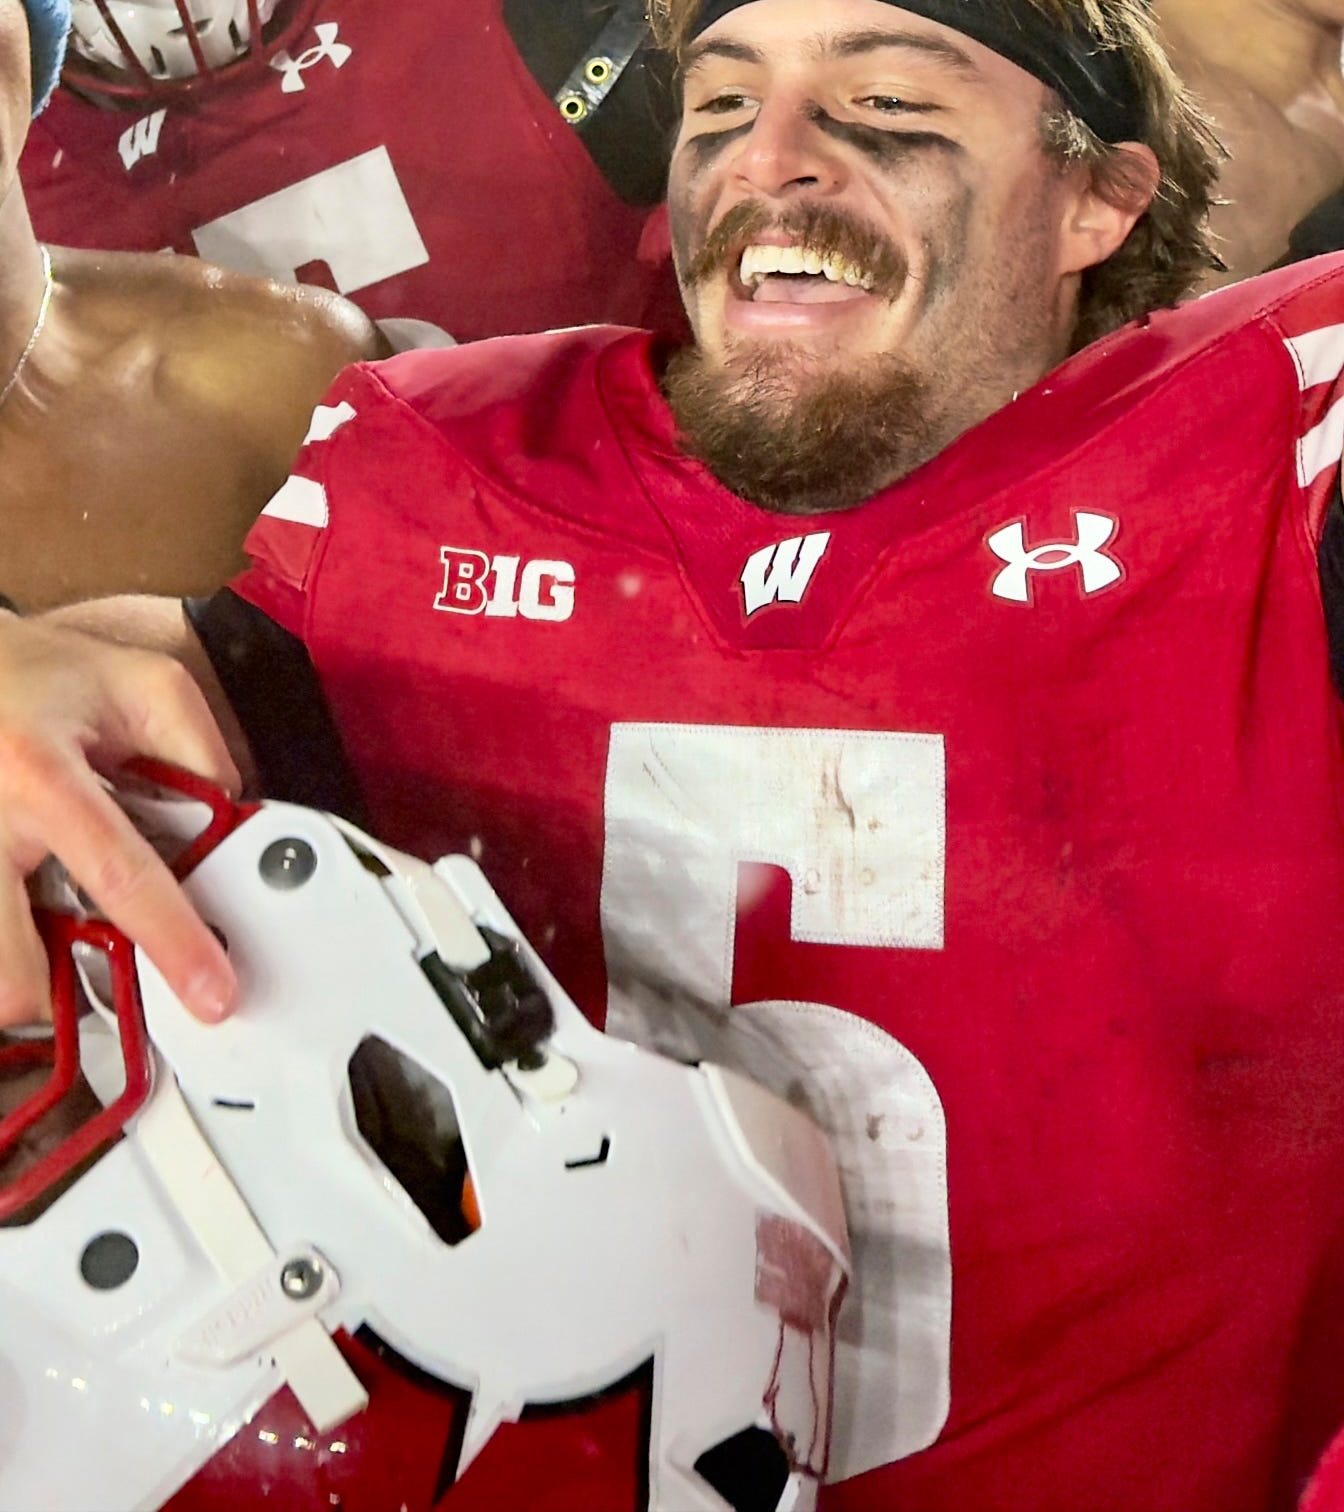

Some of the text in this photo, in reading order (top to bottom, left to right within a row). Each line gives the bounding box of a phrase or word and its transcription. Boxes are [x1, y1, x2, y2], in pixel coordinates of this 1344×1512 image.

[117, 107, 167, 171] W
[739, 531, 831, 617] W
[601, 721, 952, 1484] 5
